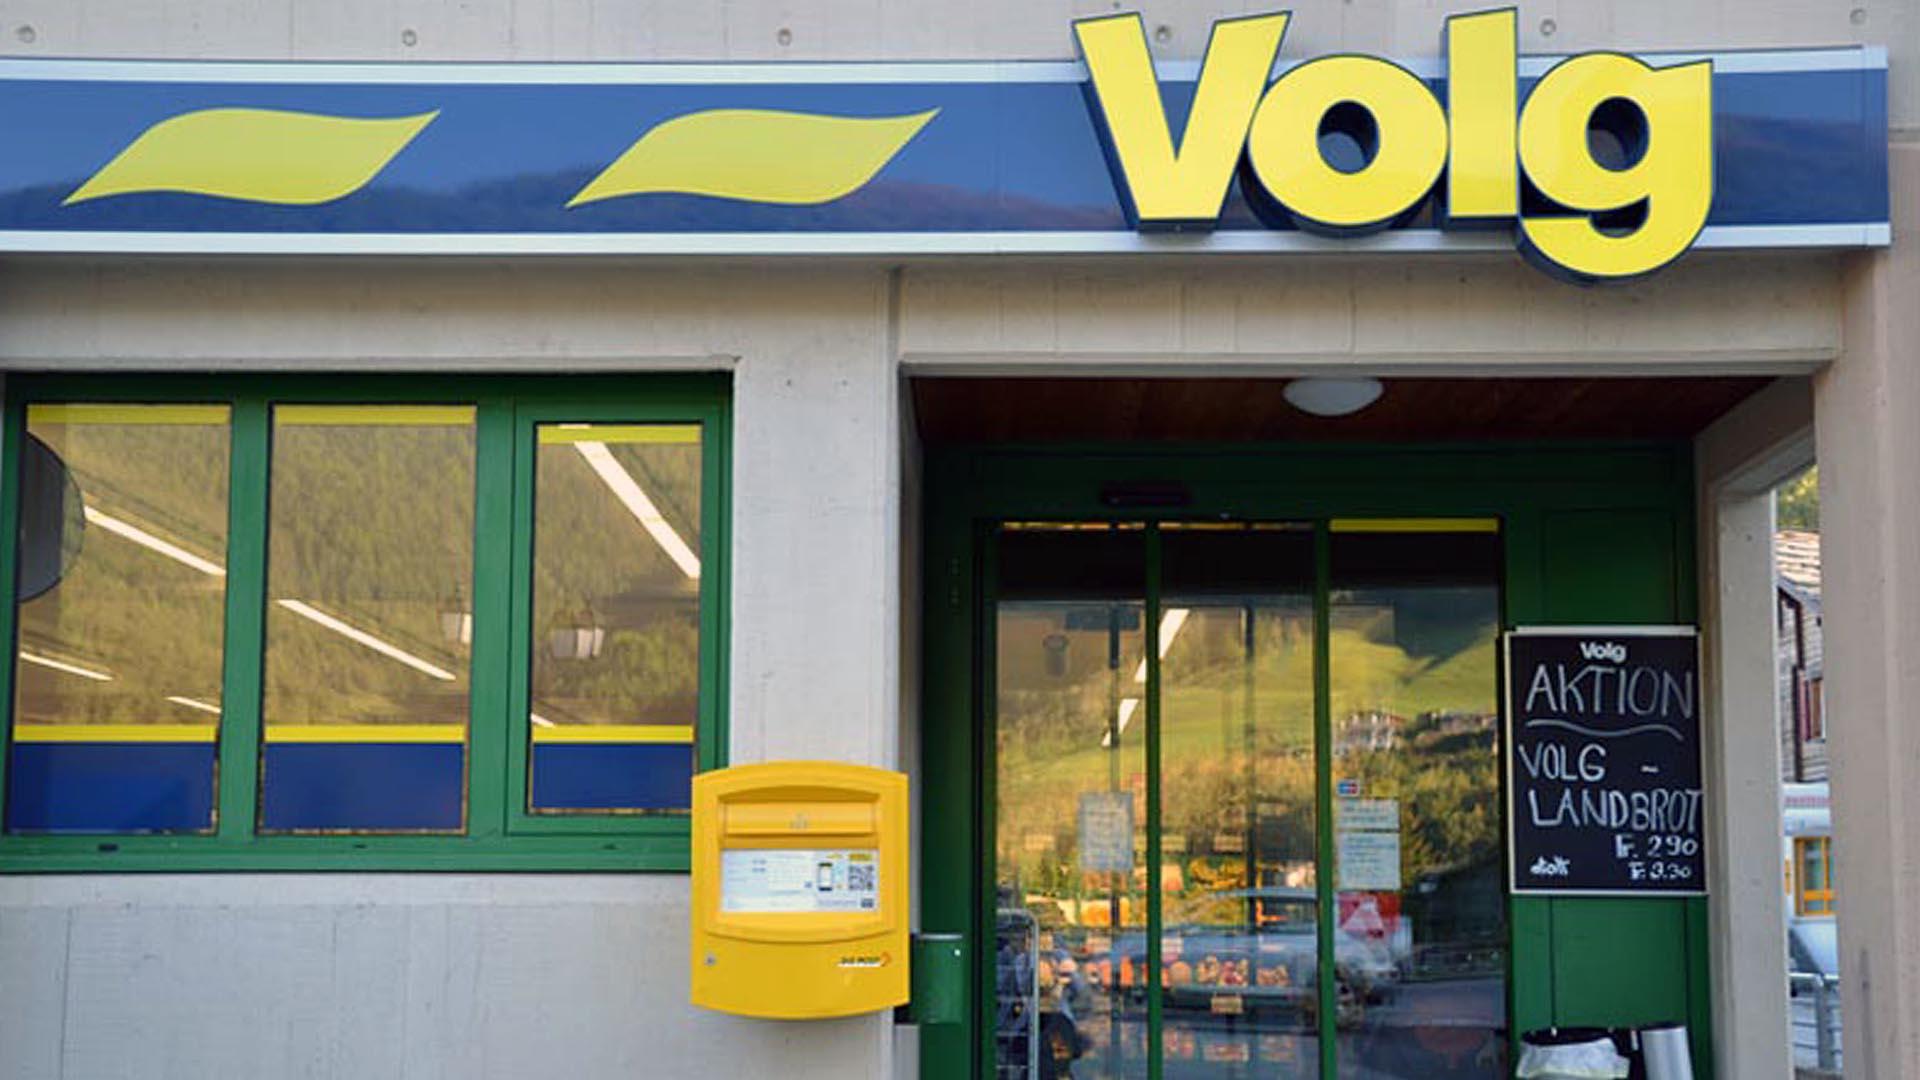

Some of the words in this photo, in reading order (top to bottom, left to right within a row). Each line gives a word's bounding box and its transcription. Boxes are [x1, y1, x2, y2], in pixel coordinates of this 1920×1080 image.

[1072, 6, 1713, 280] Volg
[1580, 641, 1627, 663] Volg
[1525, 664, 1693, 719] AKTION
[1518, 741, 1606, 782] VOLG
[1528, 788, 1702, 832] LANDBROT
